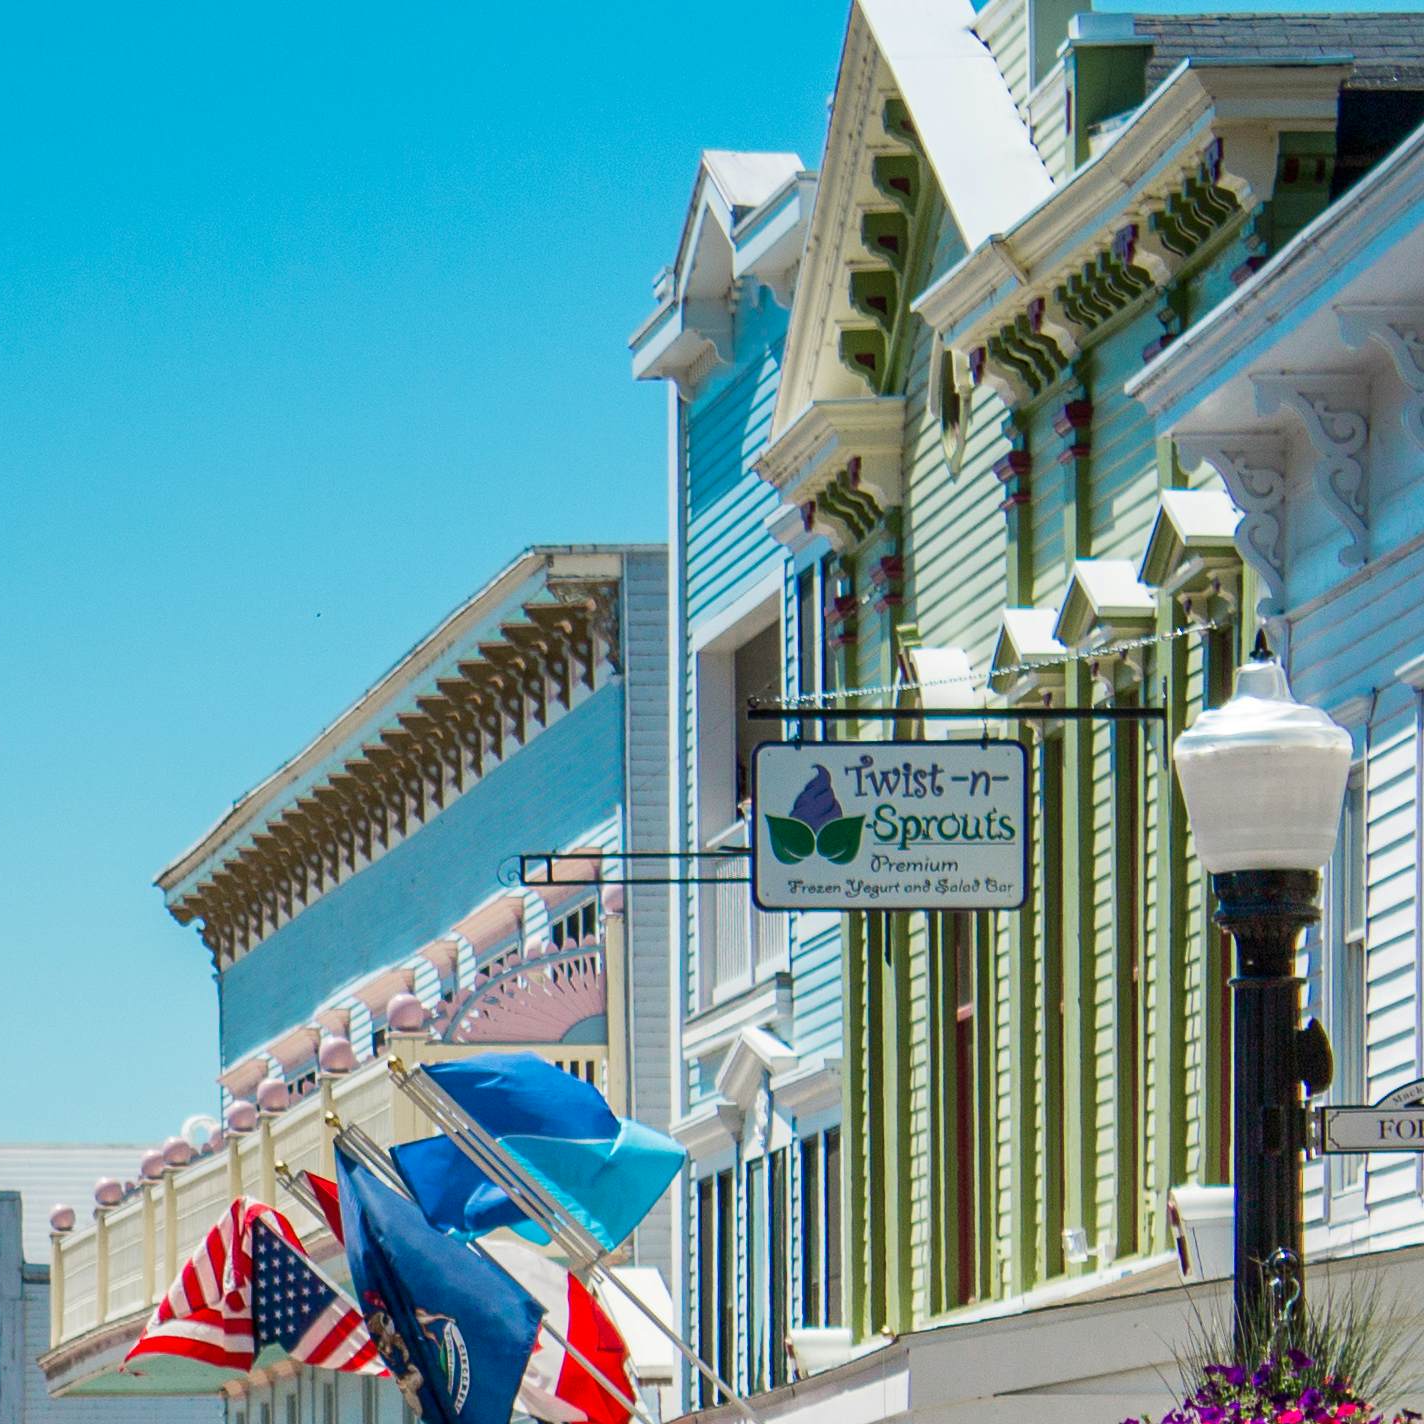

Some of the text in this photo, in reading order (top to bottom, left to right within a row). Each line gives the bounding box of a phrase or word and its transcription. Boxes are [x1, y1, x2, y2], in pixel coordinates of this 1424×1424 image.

[845, 756, 944, 798] Twist
[865, 804, 1016, 850] Sprouts
[870, 854, 959, 873] Premium
[787, 879, 842, 894] Frozen
[904, 878, 931, 893] and
[935, 878, 981, 894] Salad
[984, 877, 1014, 895] Bar
[1392, 1085, 1424, 1105] Mack
